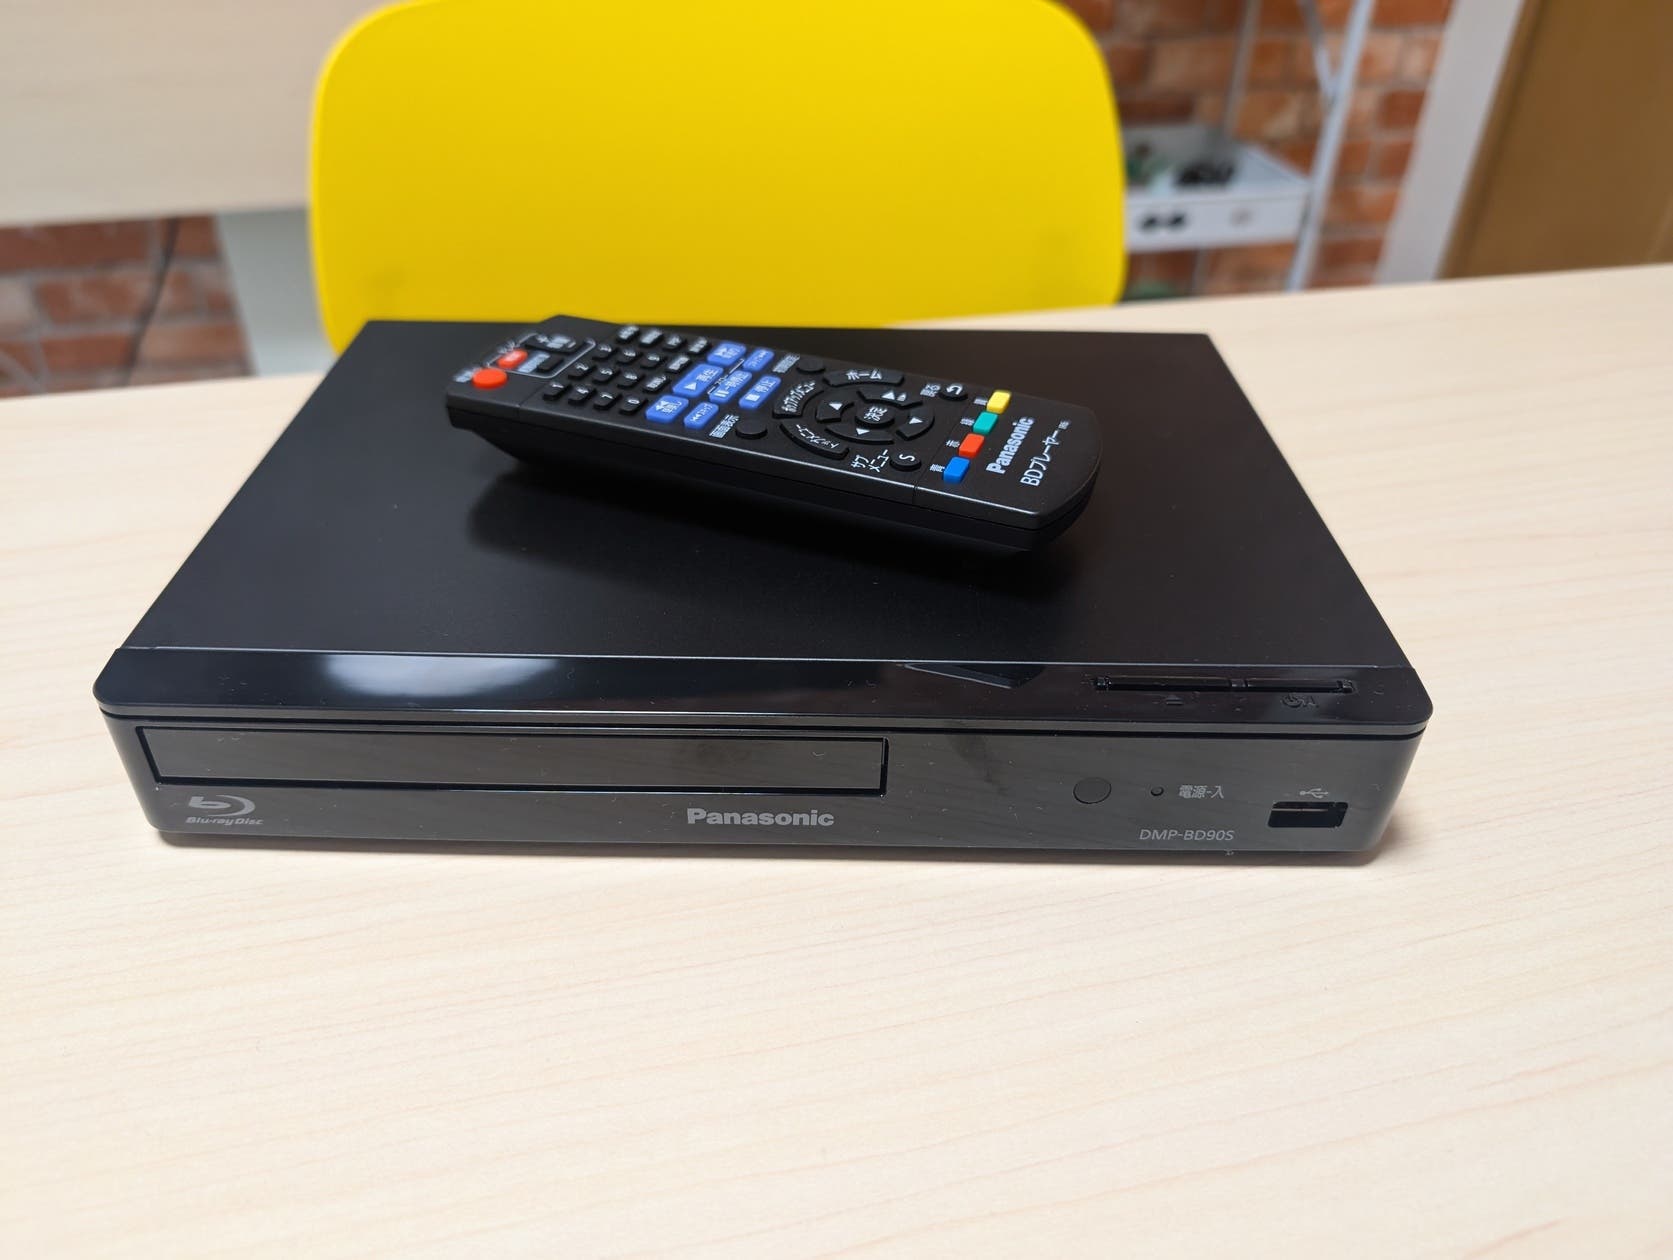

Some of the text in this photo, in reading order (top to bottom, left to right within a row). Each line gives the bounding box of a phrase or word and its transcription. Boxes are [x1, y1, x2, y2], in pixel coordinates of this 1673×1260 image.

[846, 369, 882, 381] ホーム
[864, 406, 888, 422] 決定
[985, 416, 1035, 475] Panasonic
[851, 454, 869, 468] サブ
[868, 449, 889, 472] メニュー
[1020, 430, 1060, 487] BDプレーヤー
[185, 816, 234, 826] Blu-ray
[686, 808, 835, 826] Panasonic
[1139, 829, 1236, 841] DMP-BD90S
